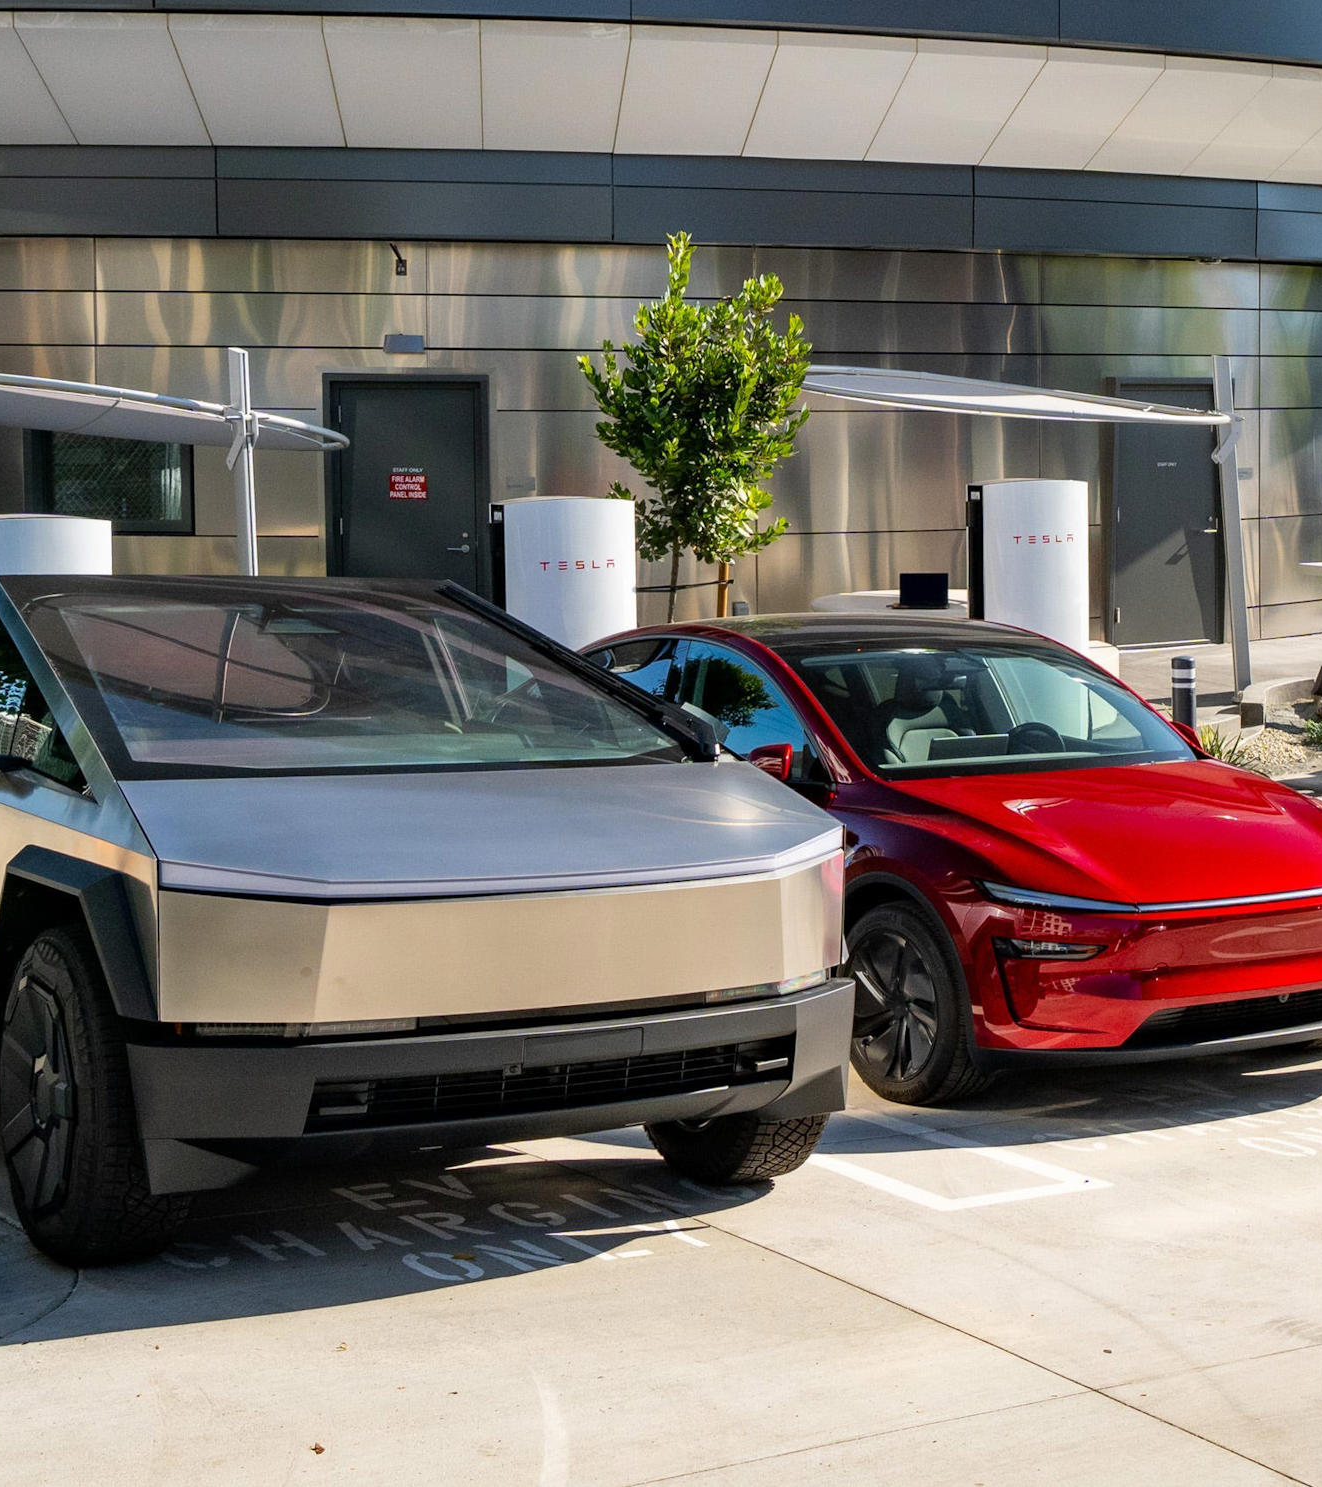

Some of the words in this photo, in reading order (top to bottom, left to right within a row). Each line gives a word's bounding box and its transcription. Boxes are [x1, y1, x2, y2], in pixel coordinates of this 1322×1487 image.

[391, 475, 405, 483] FIRE
[405, 475, 425, 483] ALARM
[394, 483, 422, 491] CONTROL
[389, 491, 408, 499] PANEL
[408, 491, 427, 499] INSIDE
[1013, 532, 1075, 545] TESLA
[539, 558, 616, 572] TESLA
[331, 1173, 477, 1212] EV
[400, 1218, 712, 1282] ONLY
